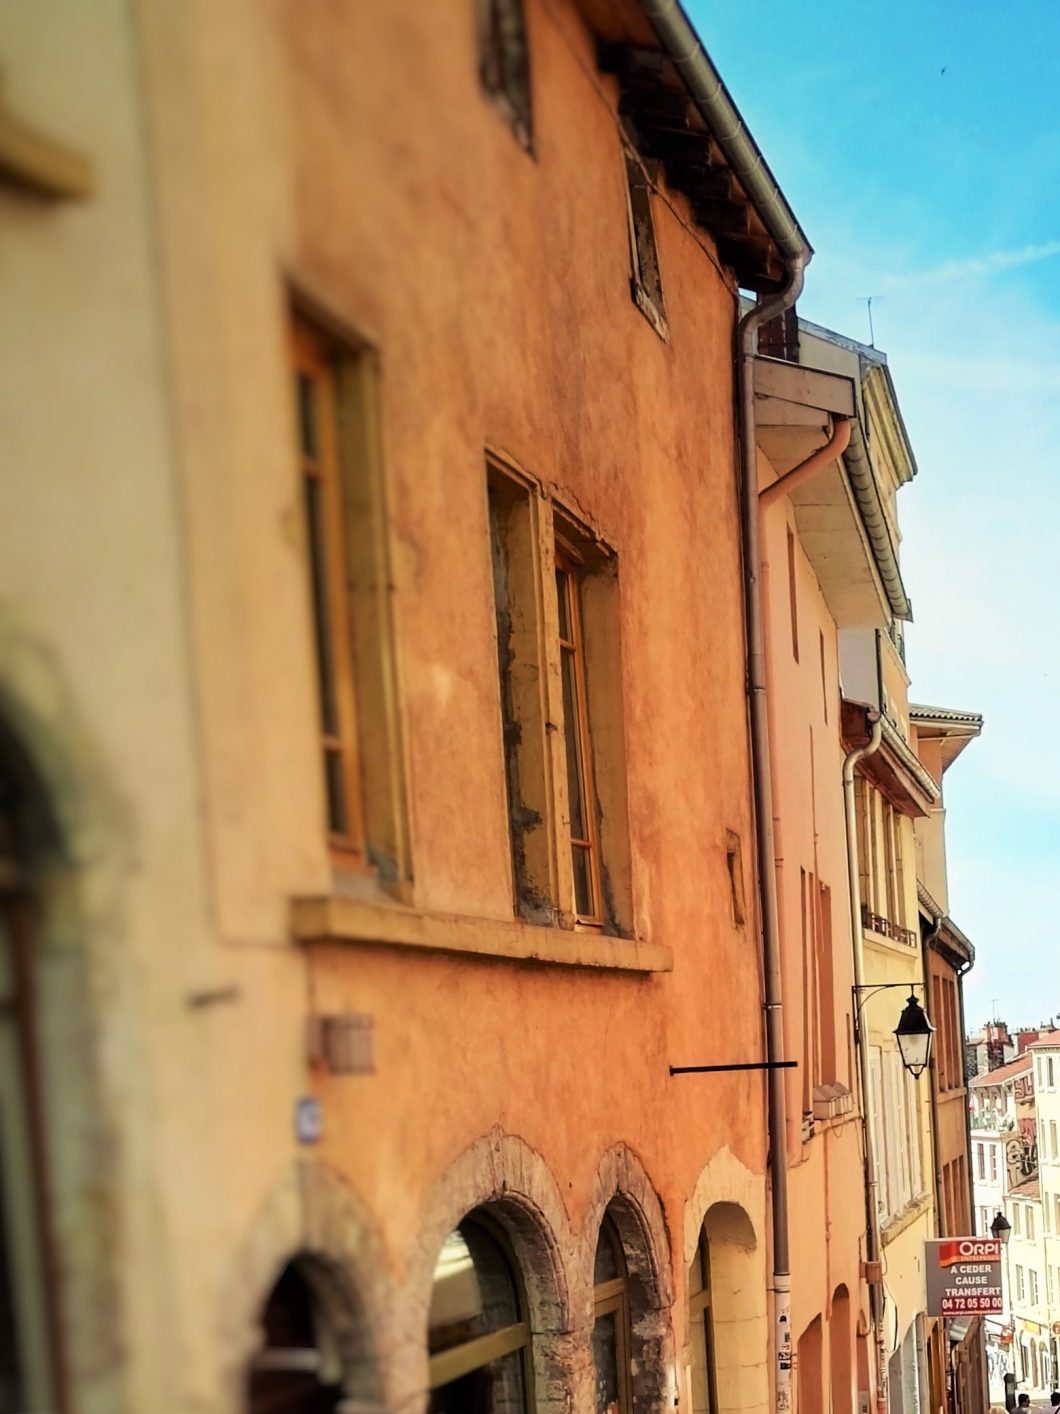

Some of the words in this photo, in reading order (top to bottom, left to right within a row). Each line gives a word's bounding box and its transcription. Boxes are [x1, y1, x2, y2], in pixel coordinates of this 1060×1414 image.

[959, 1242, 999, 1255] ORPI
[950, 1266, 958, 1274] A
[960, 1265, 992, 1273] CEDER
[955, 1276, 987, 1285] CAUSE
[945, 1287, 1001, 1297] TRANSFERT
[942, 1299, 953, 1309] 04
[955, 1299, 966, 1309] 72
[967, 1298, 978, 1309] 05
[979, 1297, 990, 1308] 50
[991, 1297, 1002, 1308] 00
